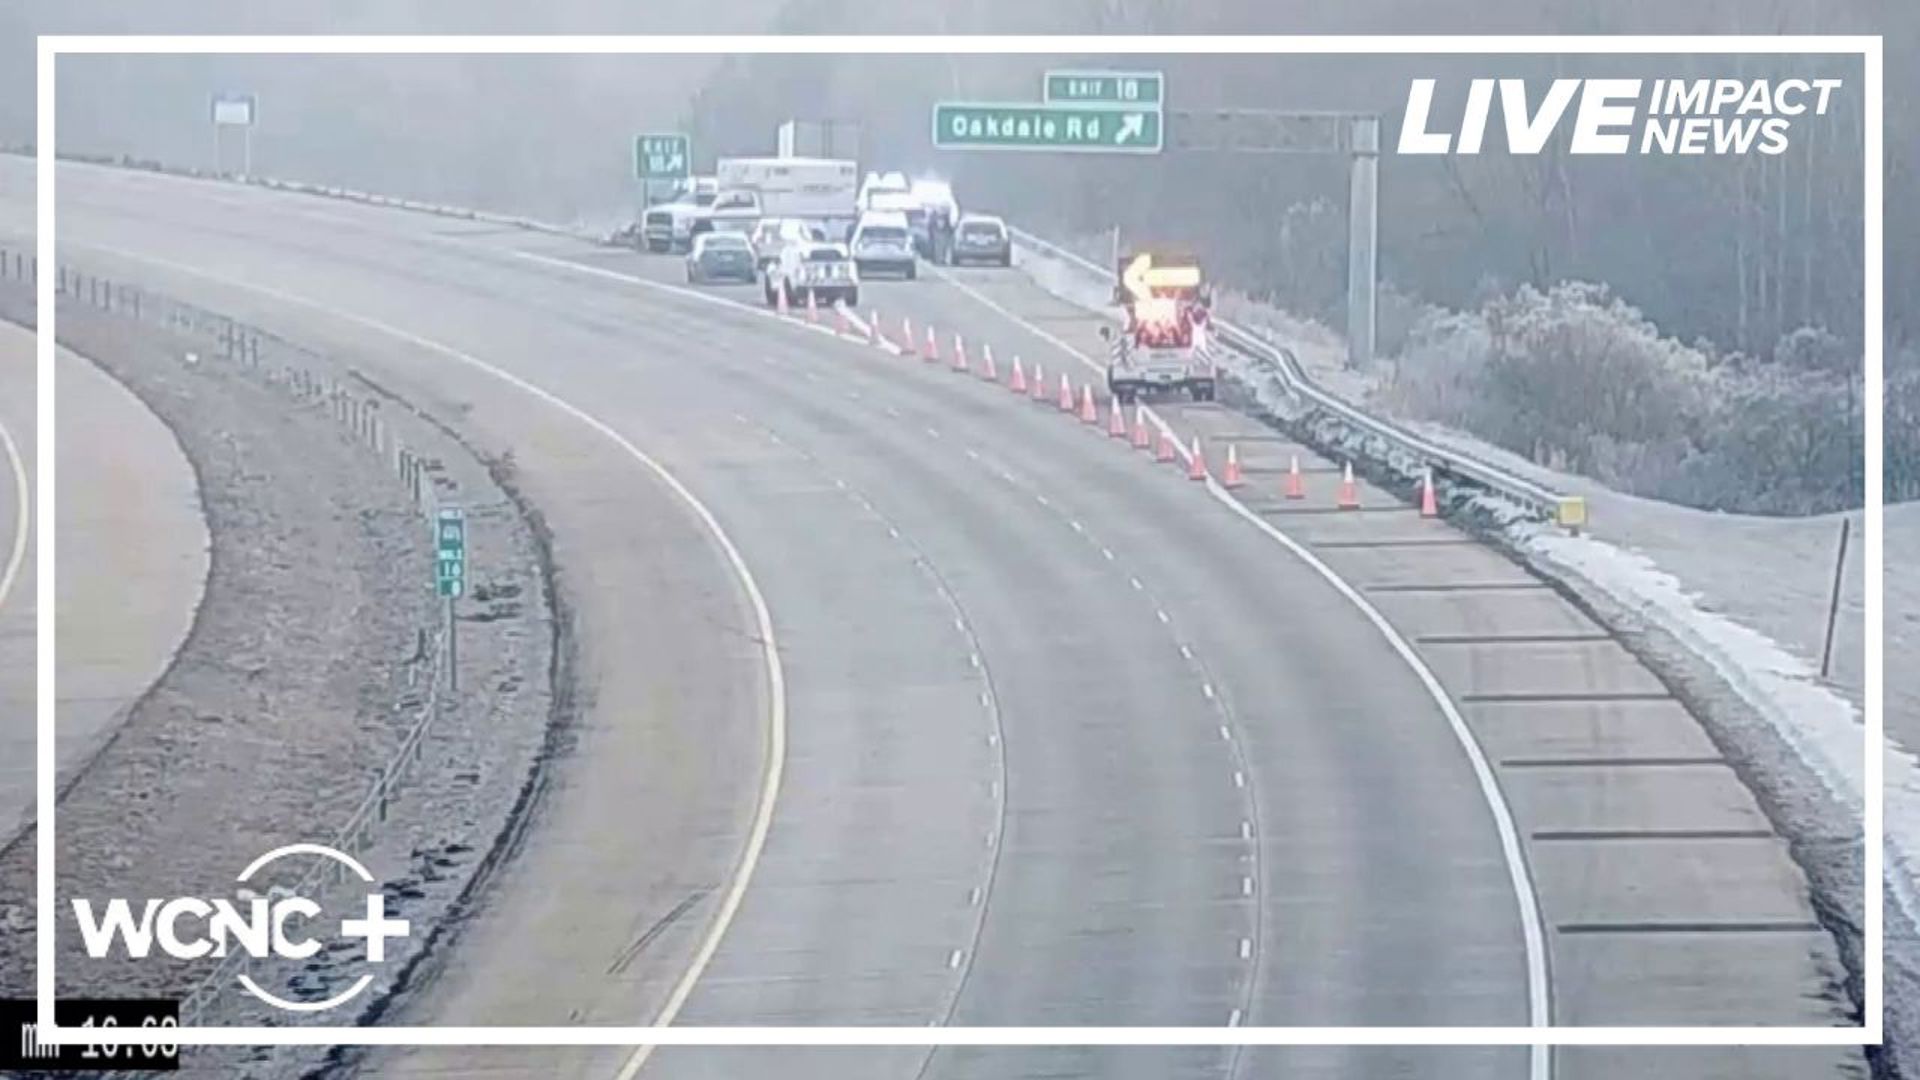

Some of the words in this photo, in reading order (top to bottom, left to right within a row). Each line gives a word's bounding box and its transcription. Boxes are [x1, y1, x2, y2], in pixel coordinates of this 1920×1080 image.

[1069, 79, 1102, 96] EXIT
[952, 114, 1056, 138] Oakdale
[1067, 117, 1100, 140] Rd
